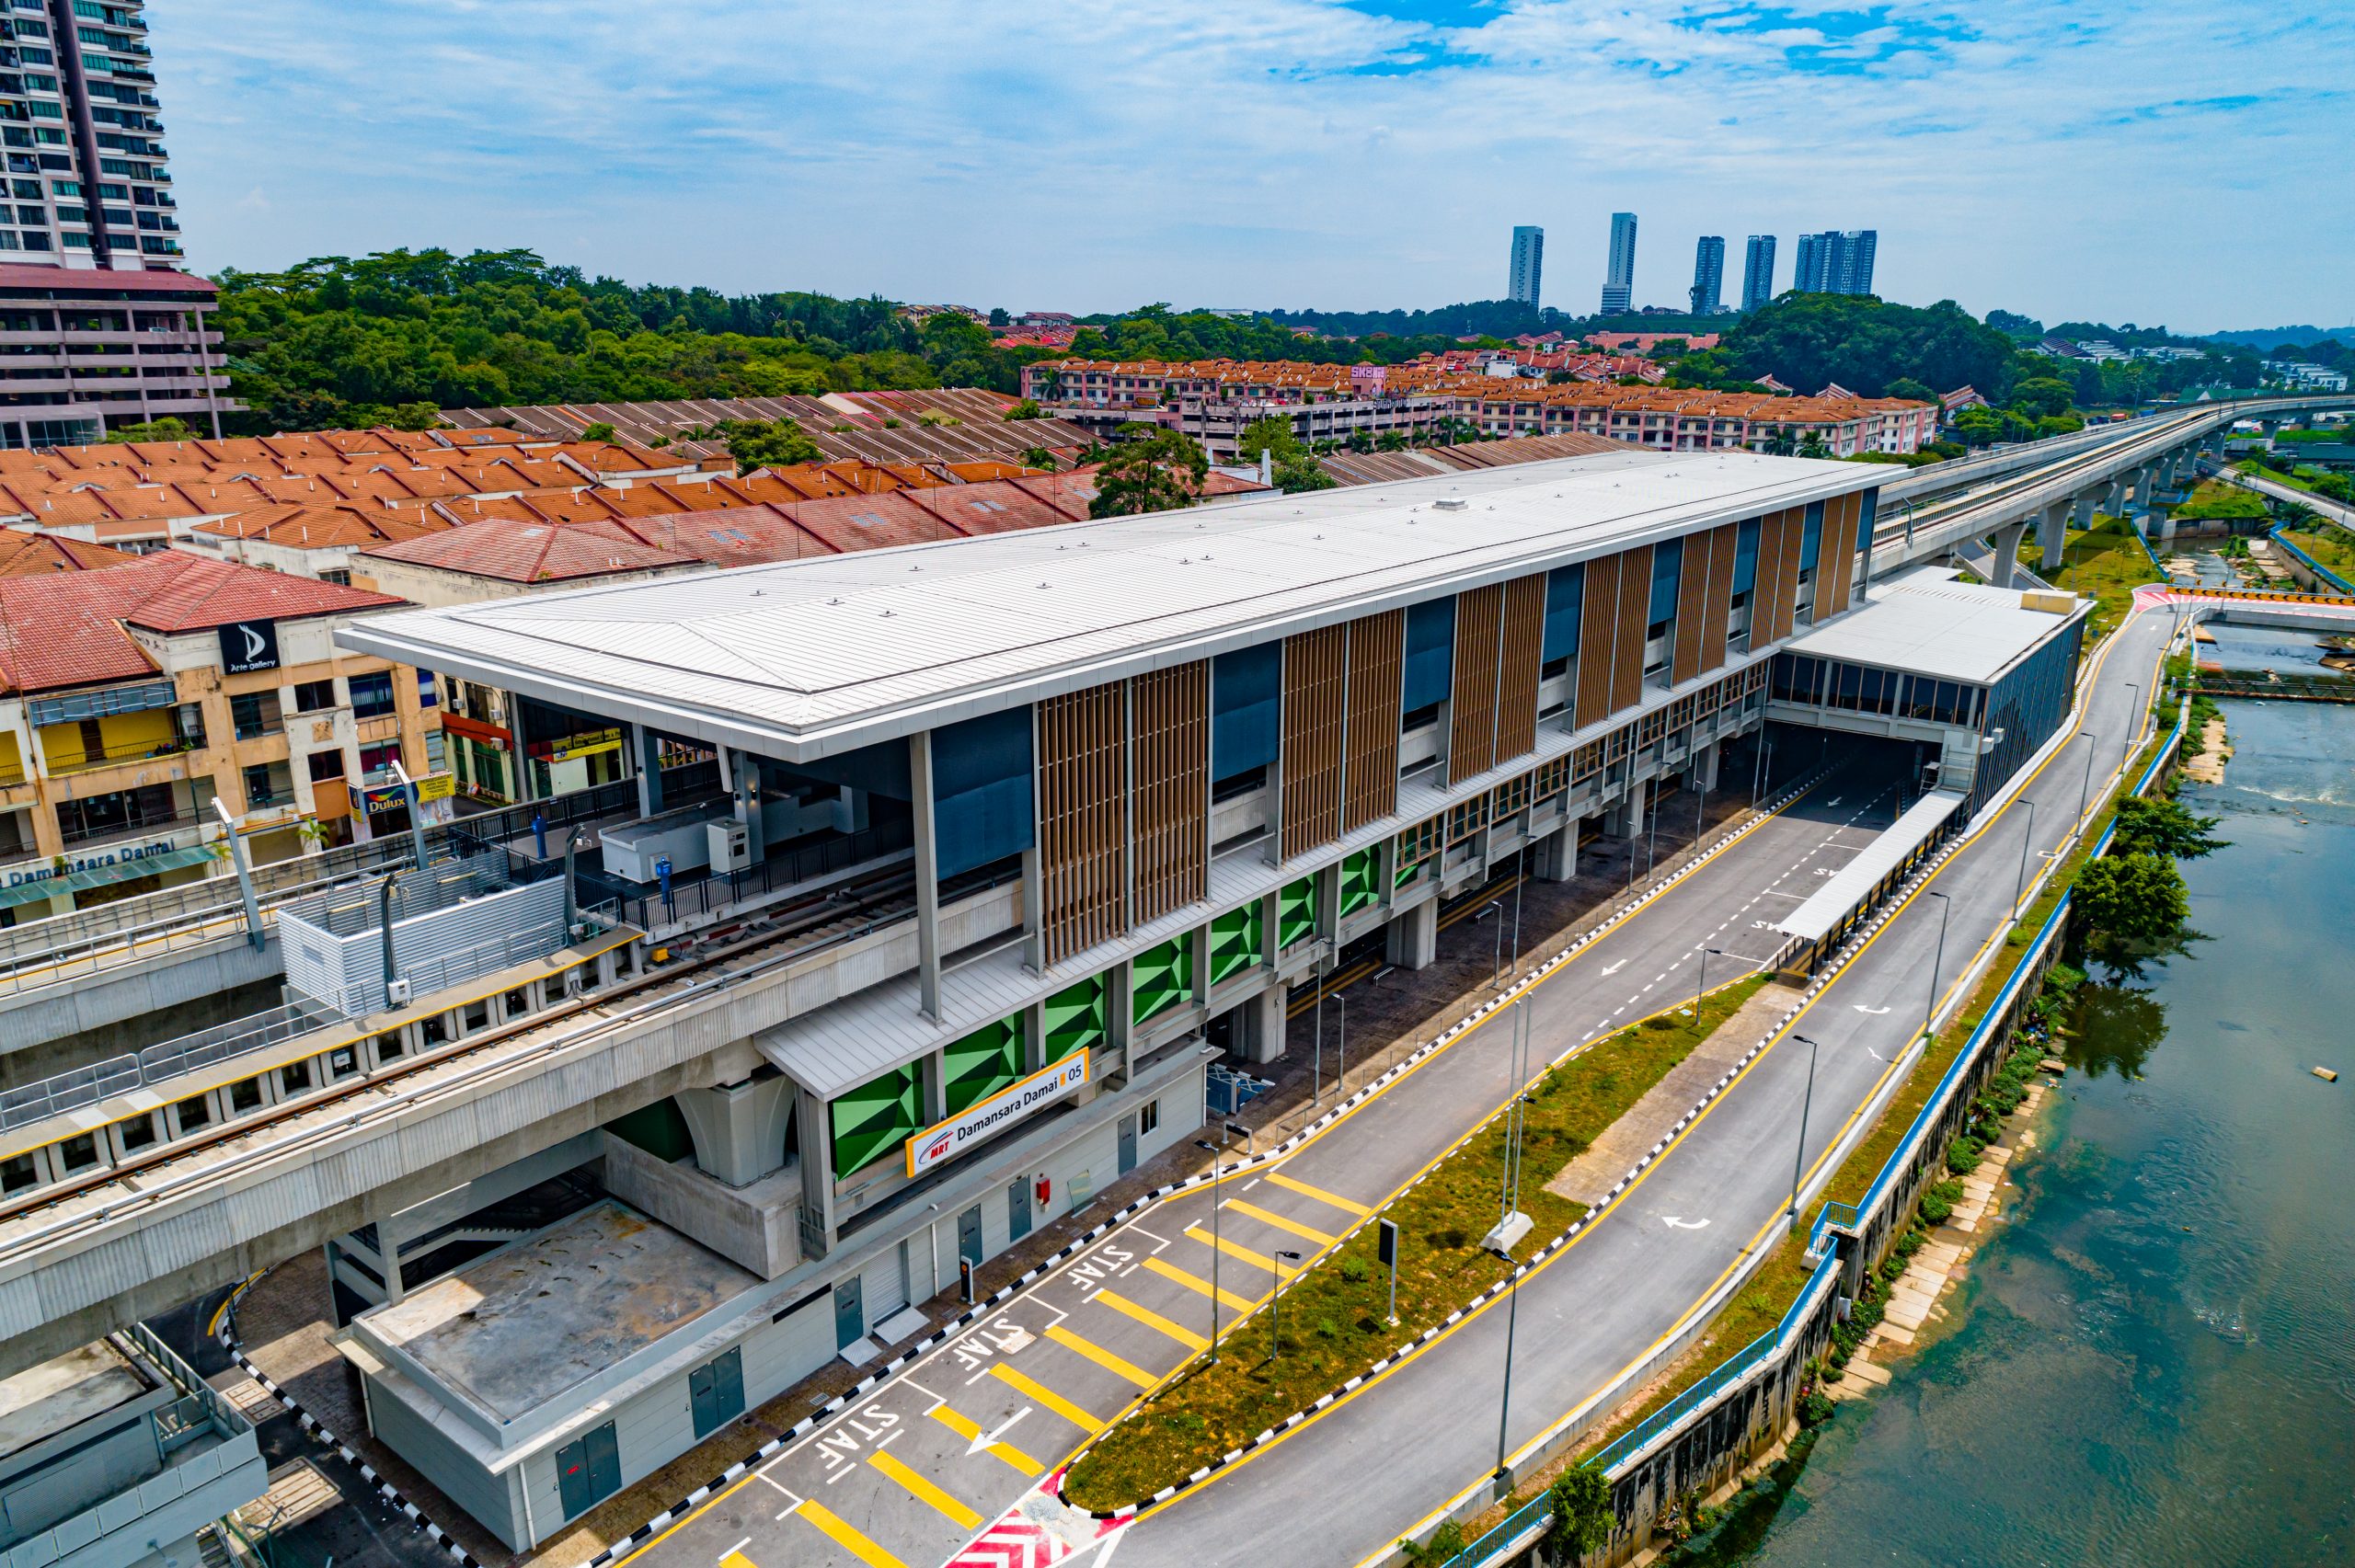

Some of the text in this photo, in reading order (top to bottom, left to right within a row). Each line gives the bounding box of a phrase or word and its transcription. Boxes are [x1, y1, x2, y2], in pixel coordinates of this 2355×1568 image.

[249, 660, 275, 670] gallery
[369, 797, 405, 812] Dulux
[9, 853, 116, 887] Damansara
[121, 838, 175, 863] Damai
[930, 1141, 949, 1160] MRT
[958, 1100, 1021, 1141] Damansara
[1024, 1077, 1058, 1105] Damai
[1068, 1064, 1082, 1082] 05
[1067, 1245, 1133, 1290] STAF
[953, 1318, 1025, 1371] STAF
[815, 1404, 899, 1470] STAF
